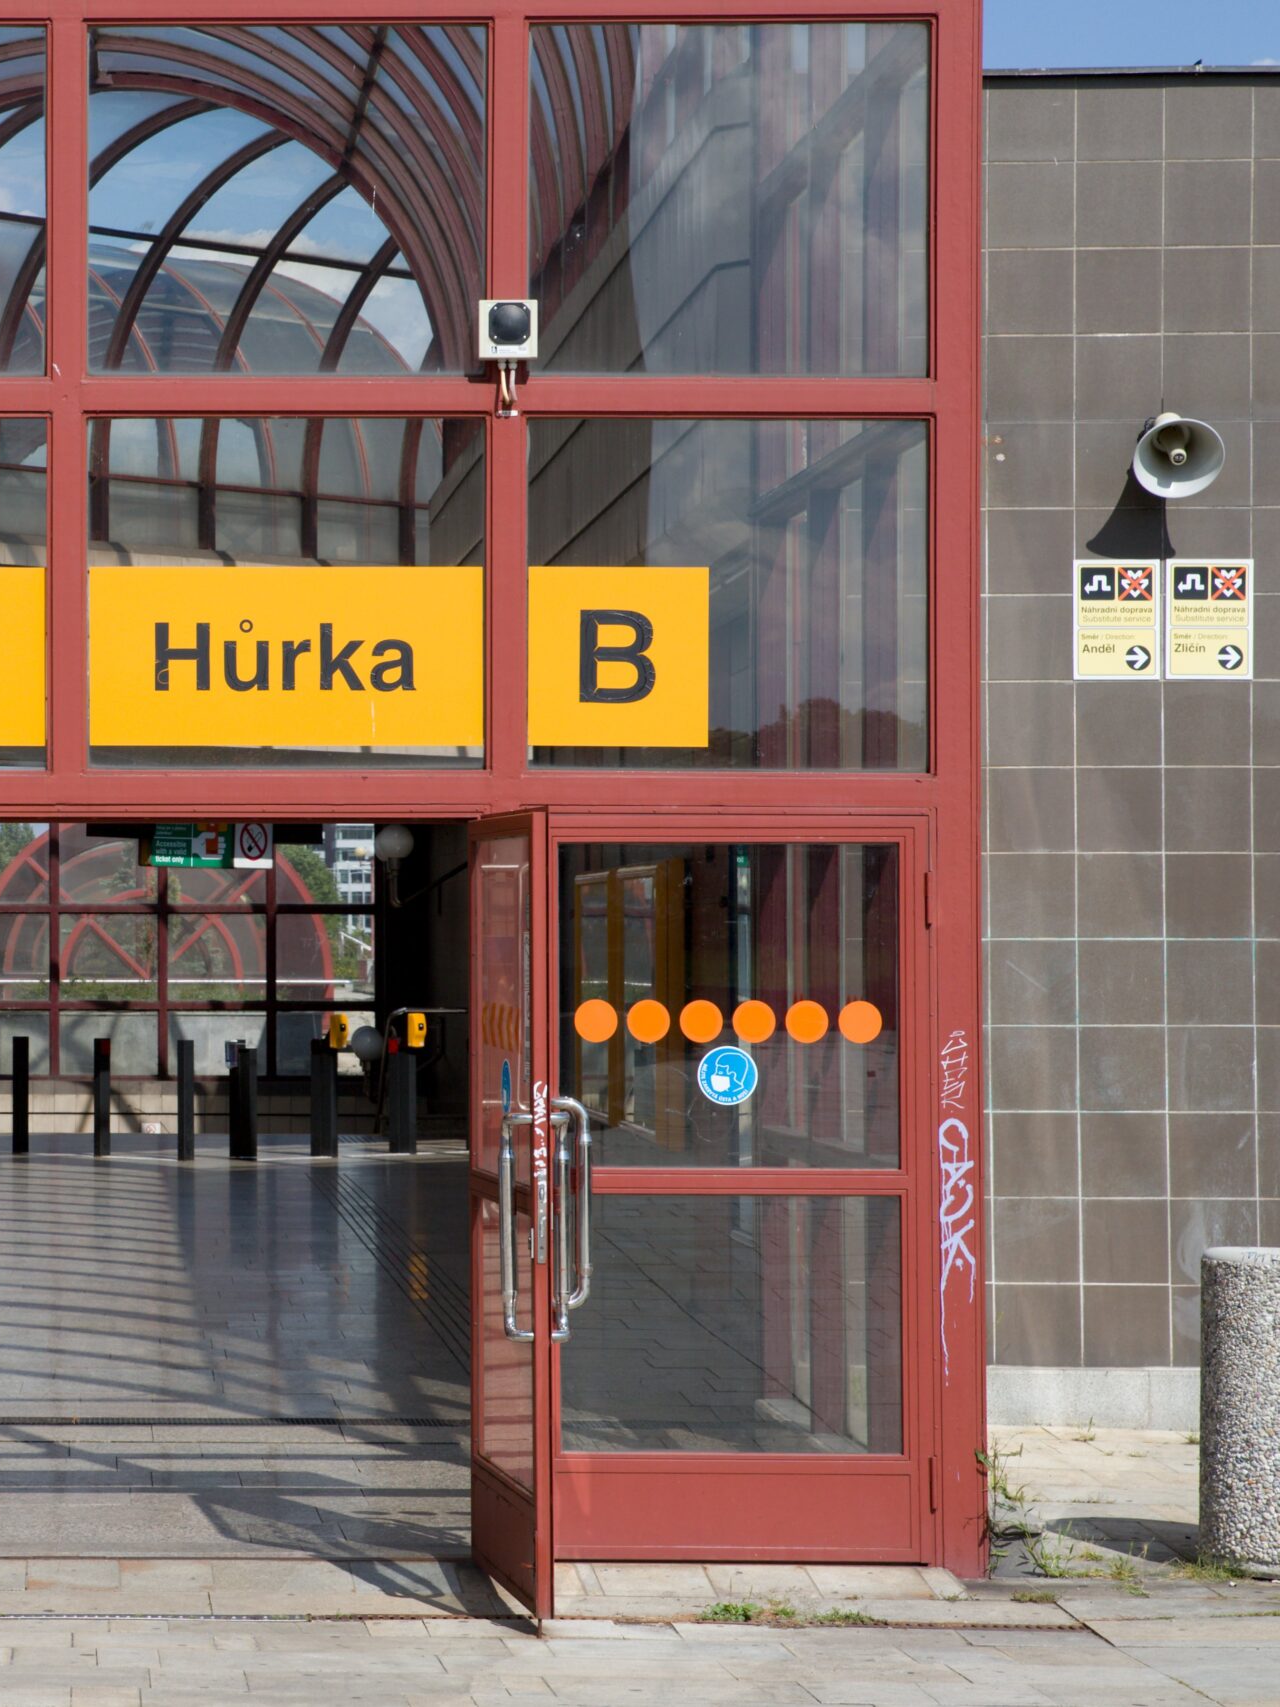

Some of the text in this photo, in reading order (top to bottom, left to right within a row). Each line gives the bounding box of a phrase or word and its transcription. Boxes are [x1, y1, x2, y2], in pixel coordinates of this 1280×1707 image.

[1120, 606, 1153, 615] doprava
[1213, 606, 1246, 615] doprava
[1082, 615, 1122, 623] Substitute
[1175, 614, 1245, 623] Substitute service
[1082, 643, 1115, 654] Anděl
[1174, 643, 1206, 653] Zličín
[154, 619, 416, 692] Hůrka
[579, 609, 656, 703] B
[172, 857, 184, 865] only
